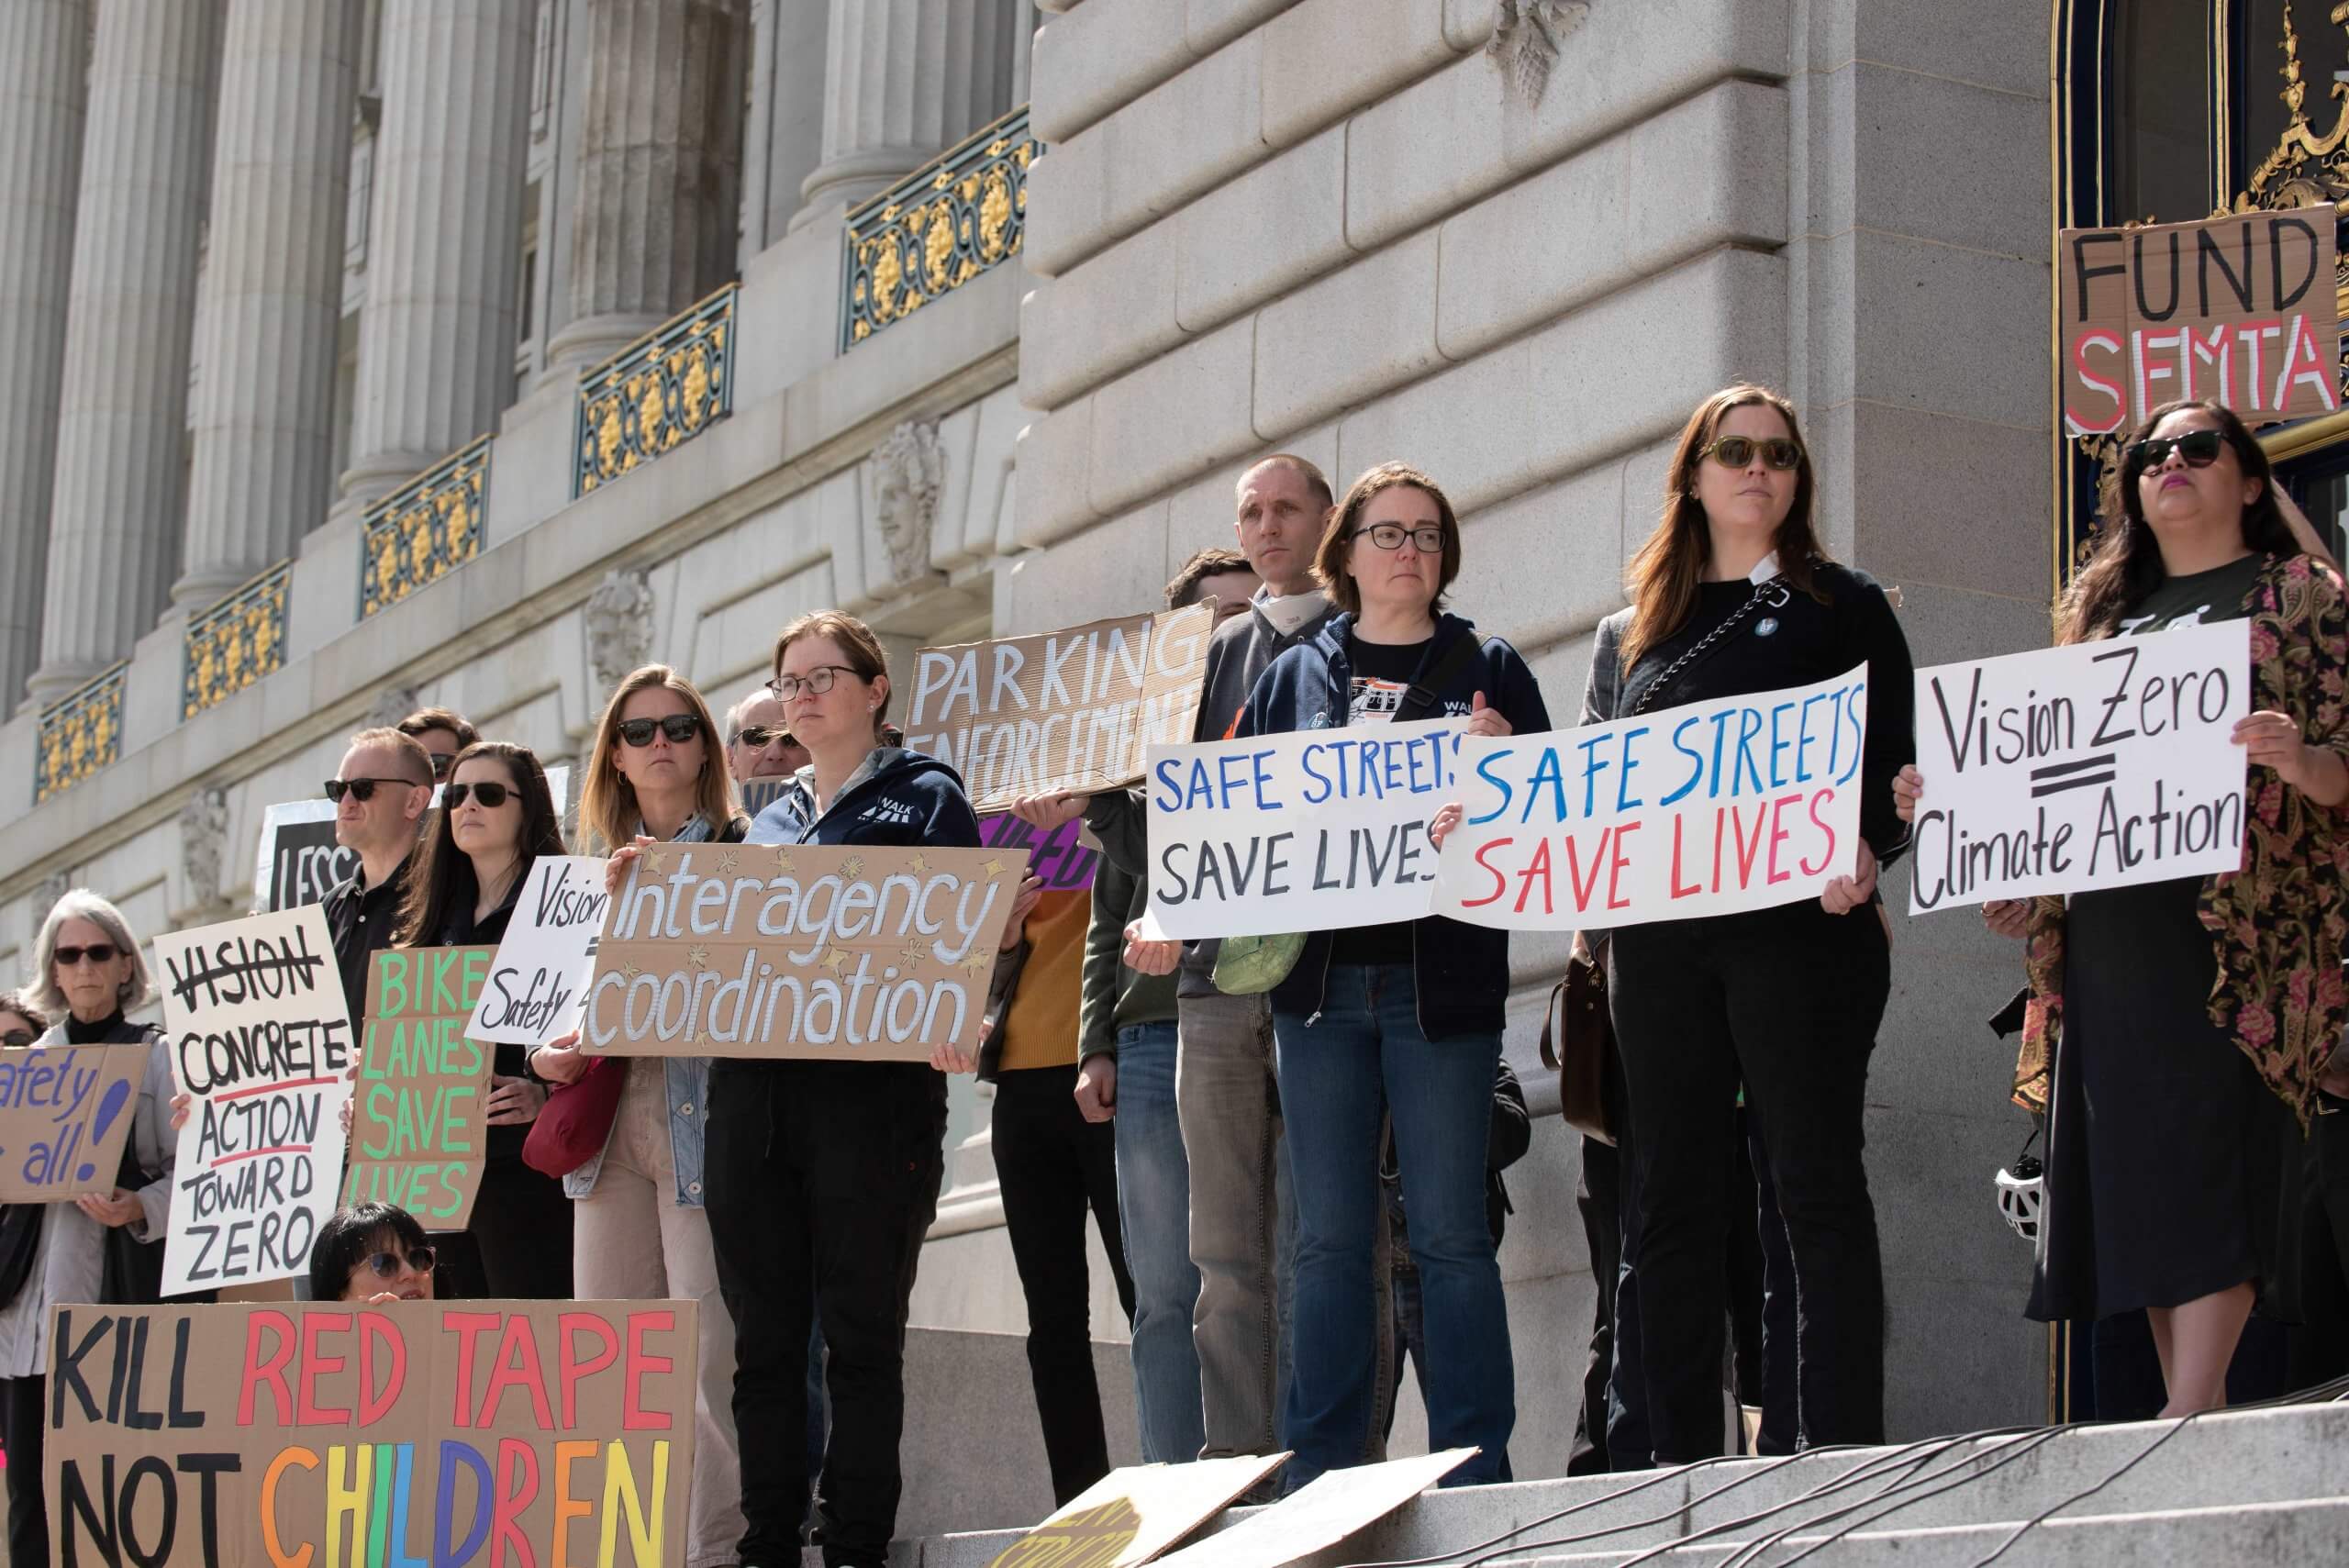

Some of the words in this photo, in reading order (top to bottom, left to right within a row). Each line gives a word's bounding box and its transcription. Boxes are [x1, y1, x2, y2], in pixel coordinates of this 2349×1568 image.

[2073, 217, 2319, 322] FUND
[2065, 314, 2341, 436] SFMTA
[911, 605, 1206, 725] PARKING
[1443, 701, 1473, 714] WAL
[1931, 667, 2075, 773] Vision
[2089, 646, 2230, 748] Zero
[1155, 749, 1283, 813] SAFE
[1302, 729, 1469, 804] STREET
[1468, 727, 1651, 826] SAFE
[1659, 682, 1865, 807] STREETS
[1157, 830, 1294, 905] SAVE
[1461, 820, 1642, 916] SAVE
[1670, 787, 1836, 900] LIVES
[1912, 806, 2073, 909] Climate
[2087, 779, 2241, 878] Action
[536, 862, 607, 928] Vision
[612, 852, 1000, 967] Interagency
[167, 924, 324, 1013] VISION
[377, 949, 489, 1019] BIKE
[481, 967, 572, 1040] Safety
[587, 948, 968, 1048] coordination
[0, 1049, 98, 1123] afety
[180, 1018, 348, 1095] CONCRETE
[362, 1018, 484, 1080] LANES
[197, 1092, 321, 1163] ACTION
[362, 1082, 476, 1161] SAVE
[185, 1206, 314, 1282] ZERO
[51, 1309, 206, 1429] KILL
[235, 1310, 406, 1429] RED
[442, 1310, 675, 1431] TAPE
[60, 1452, 241, 1568] NOT
[260, 1436, 671, 1568] CHILDREN
